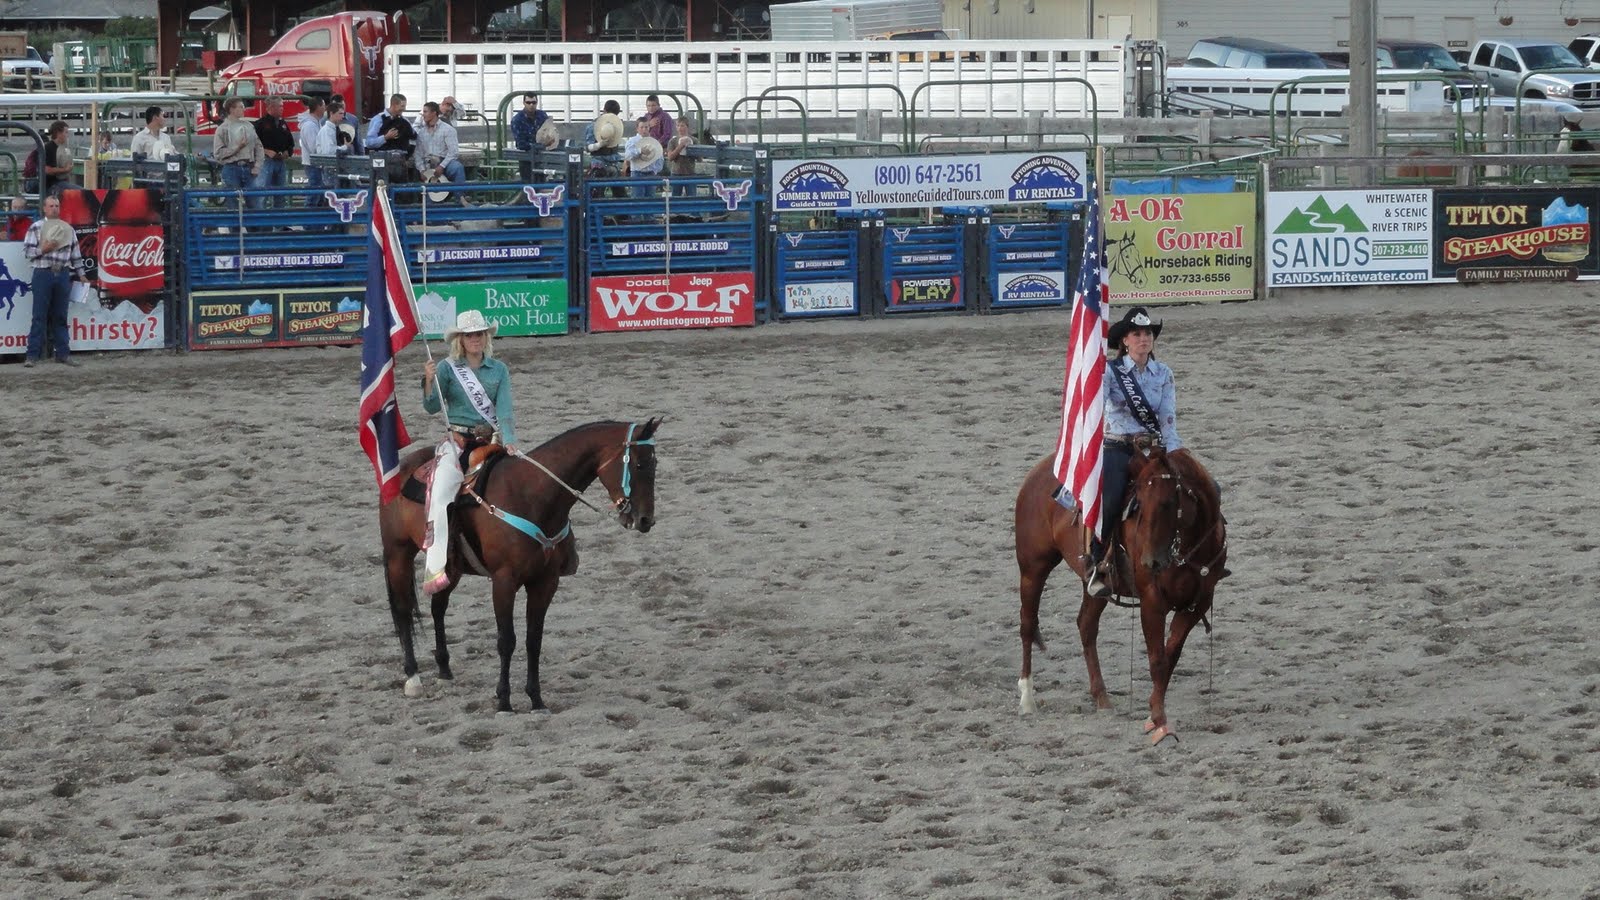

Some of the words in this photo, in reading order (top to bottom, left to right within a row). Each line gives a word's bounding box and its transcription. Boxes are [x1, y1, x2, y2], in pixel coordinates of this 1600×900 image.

[267, 81, 300, 96] WOLF
[782, 168, 800, 186] ROCKY
[800, 163, 830, 173] MOUNTAIN
[829, 168, 847, 185] TOURS
[874, 164, 911, 186] (800)
[1013, 158, 1041, 181] WYOMING
[1041, 157, 1079, 180] ADVENTURES
[778, 191, 811, 201] SUMMER
[812, 191, 819, 200] &
[820, 191, 850, 200] WINTER
[855, 187, 1005, 204] YellowstoneGuidedTours.com
[1015, 188, 1029, 200] RV
[1031, 187, 1076, 199] RENTALS
[1366, 193, 1428, 203] WHITEWATER
[1109, 197, 1185, 223] A-OK
[1384, 208, 1391, 217] &
[1395, 208, 1428, 217] SCENIC
[1446, 205, 1528, 226] TETON
[1372, 222, 1399, 232] RIVER
[1402, 222, 1428, 232] TRIPS
[1156, 225, 1244, 252] Corral
[1447, 226, 1586, 261] STEAKHOUSE
[674, 241, 699, 252] HOLE
[700, 241, 729, 251] RODEO
[1272, 236, 1370, 268] SANDS
[1373, 244, 1428, 255] 307-733-4410
[238, 255, 281, 267] ACKSON
[283, 255, 310, 266] HOLE
[311, 254, 344, 265] RODEO
[440, 249, 481, 262] JACKSON
[483, 248, 508, 259] HOLE
[509, 247, 541, 258] RODEO
[1144, 255, 1211, 269] Horseback
[1215, 254, 1253, 268] Riding
[626, 279, 671, 287] DODGE
[689, 275, 713, 288] Jeep
[1275, 271, 1426, 284] SANDSwhitewater.com
[1465, 270, 1500, 279] FAMILY
[1503, 269, 1570, 278] RESTAURANT
[903, 278, 951, 288] POWERADE
[485, 288, 531, 309] BANK
[532, 294, 550, 307] OF
[596, 283, 750, 319] WOLF
[903, 286, 951, 301] PLAY
[1108, 288, 1252, 299] ww.HorseCreekRanch.com
[199, 304, 242, 317] TETON
[290, 301, 331, 313] TETON
[290, 312, 361, 333] STEAKHOUSE
[526, 309, 565, 326] HOLE
[618, 315, 733, 328] www.wolfautogroup.com
[67, 316, 158, 345] hirsty?
[200, 315, 273, 336] STEAKHOUSE
